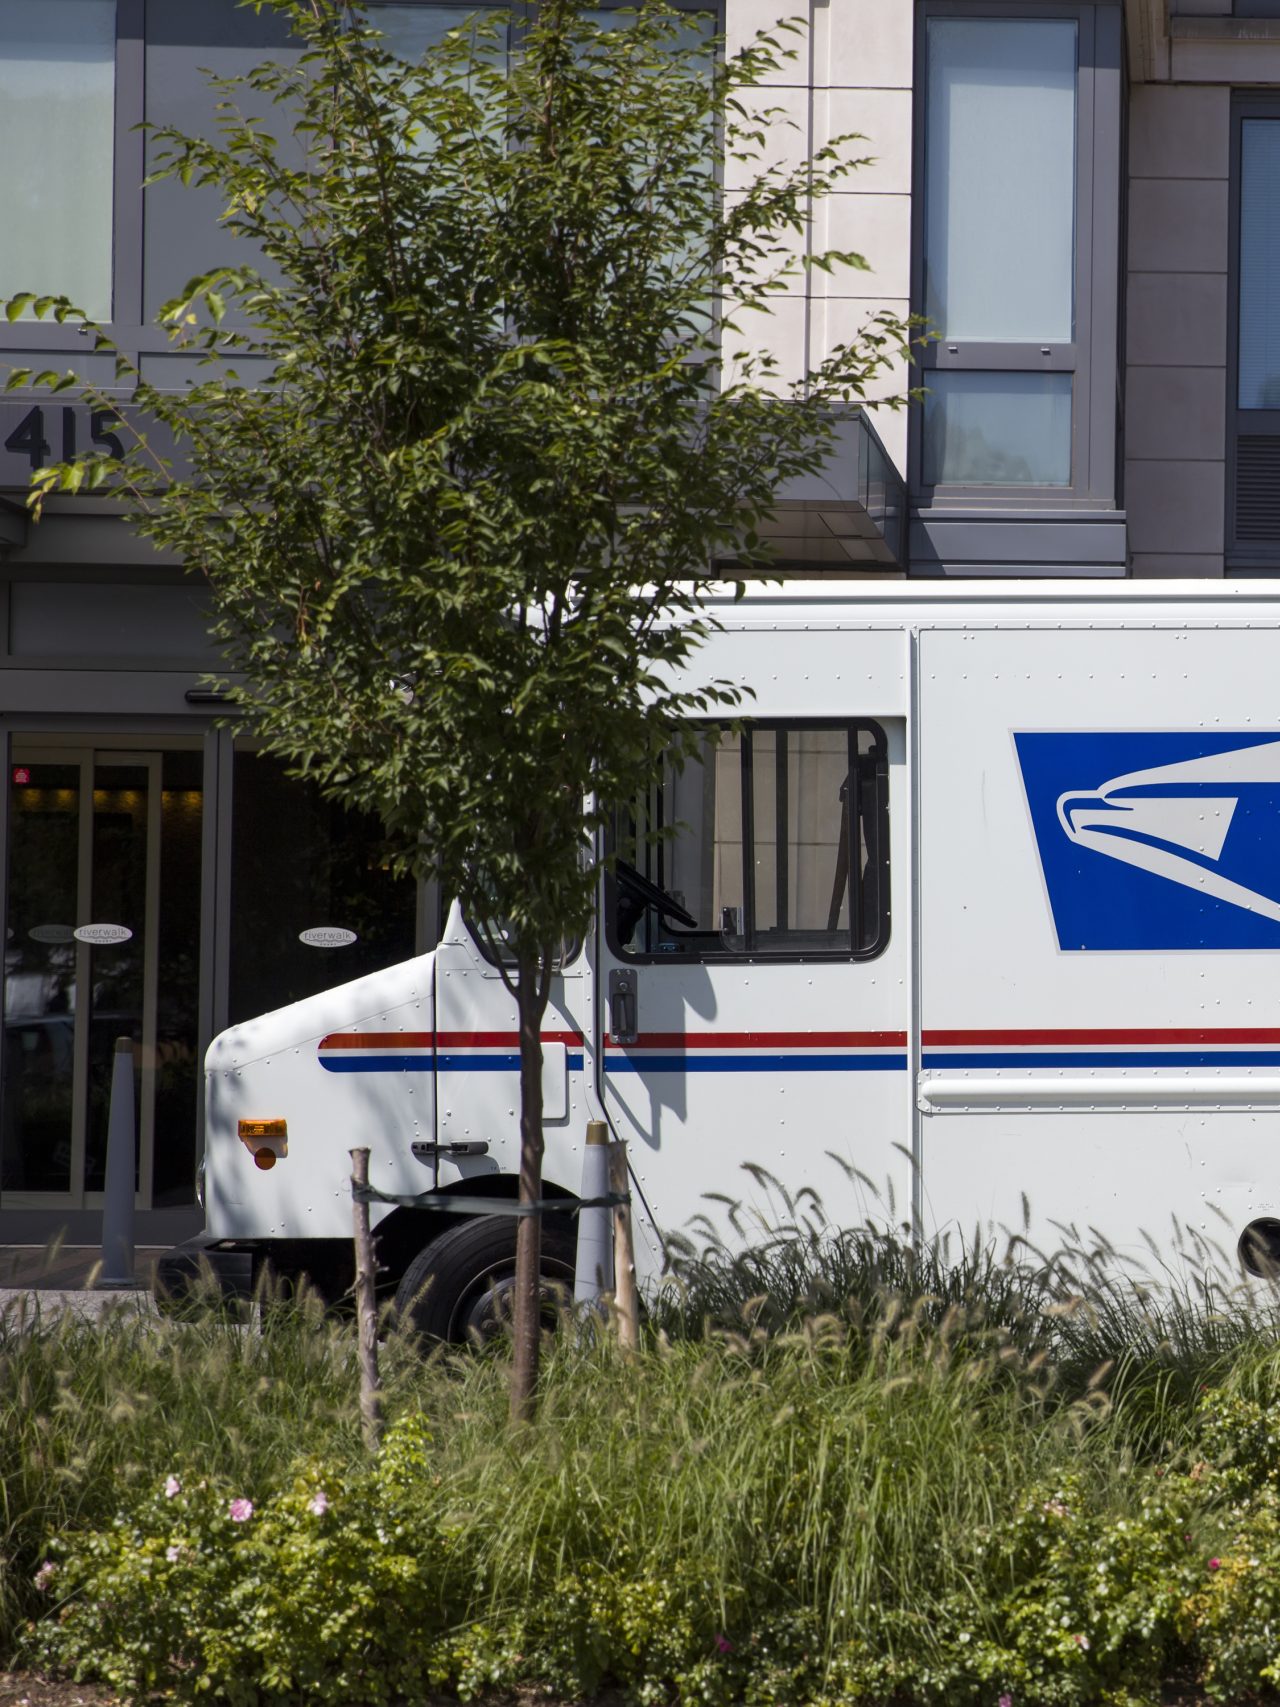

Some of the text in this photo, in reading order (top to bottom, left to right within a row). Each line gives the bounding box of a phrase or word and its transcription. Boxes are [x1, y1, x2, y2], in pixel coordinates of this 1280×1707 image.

[5, 405, 126, 468] 415
[79, 927, 126, 937] riverwalk
[304, 931, 351, 940] riverwalk
